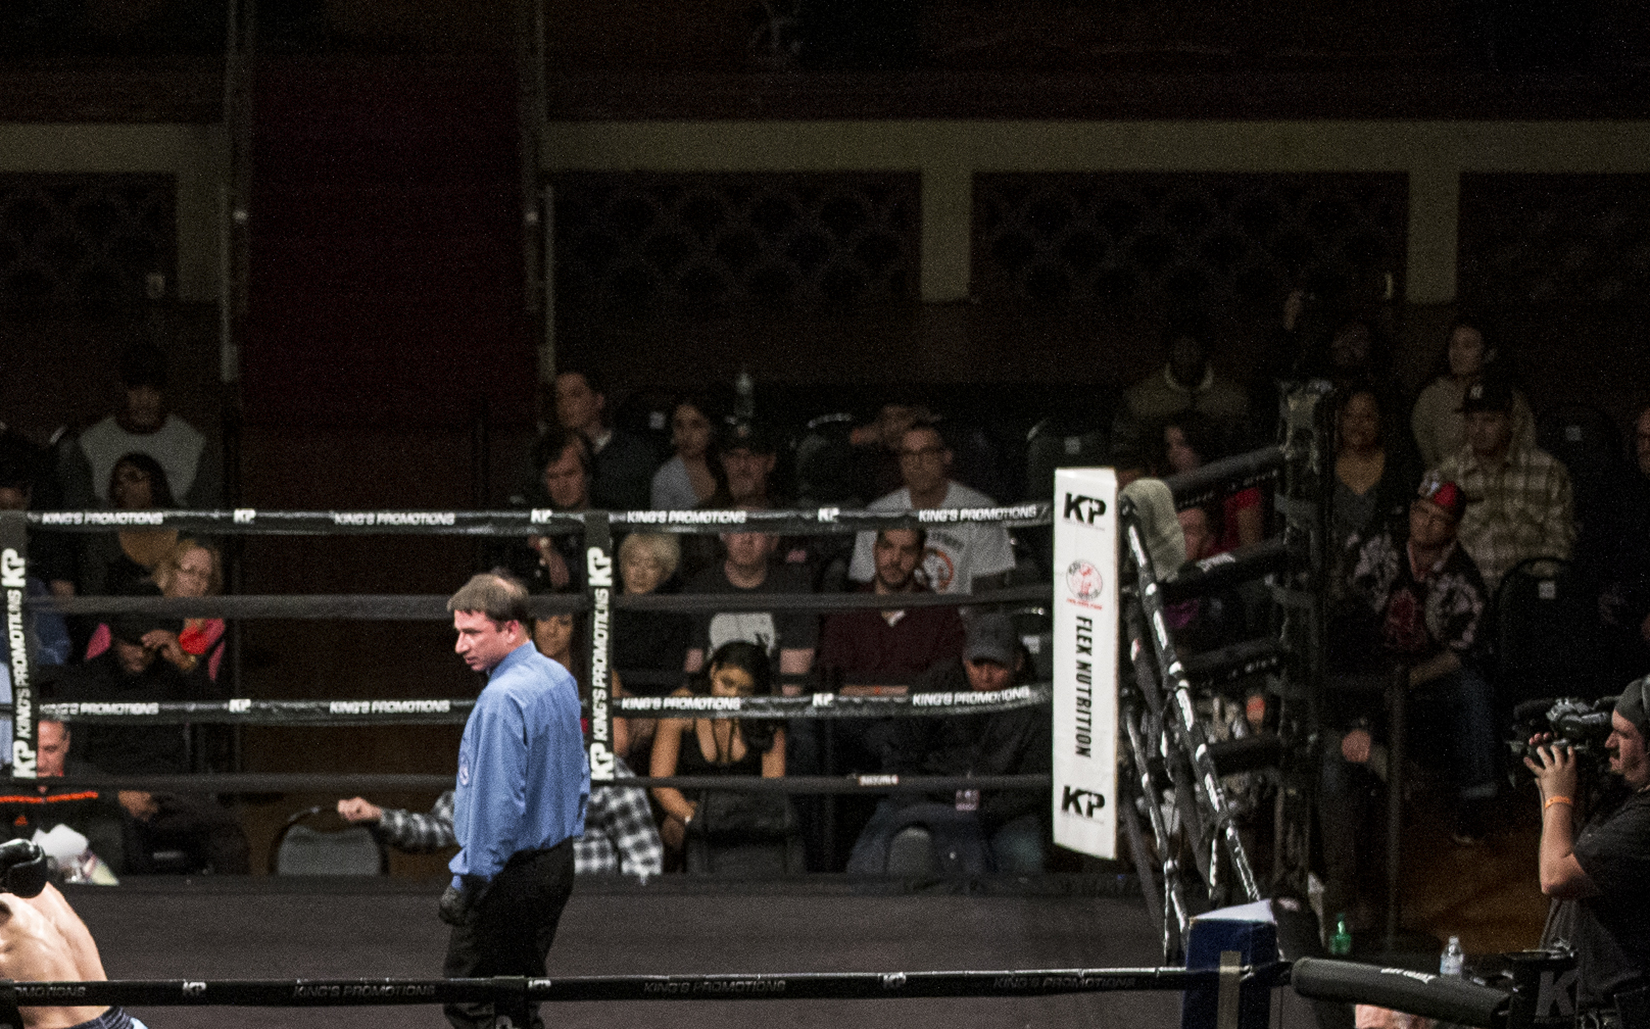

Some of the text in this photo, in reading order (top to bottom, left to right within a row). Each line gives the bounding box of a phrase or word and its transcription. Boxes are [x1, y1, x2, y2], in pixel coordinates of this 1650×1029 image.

[626, 510, 747, 525] KING'S PROMOTIONS
[918, 503, 1037, 523] KING'S PROMOTIONS
[1063, 492, 1107, 526] KP
[84, 513, 164, 525] PROMOTIONS
[334, 512, 455, 526] KING'S PROMOTIONS
[1, 548, 26, 588] KP
[1075, 614, 1093, 657] FLEX
[586, 546, 615, 781] KP KING'S PROMOTIONS KP
[329, 699, 451, 714] KING'S PROMOTIONS
[621, 696, 741, 711] KING'S PROMOTIONS
[1075, 658, 1093, 759] NUTRITION
[13, 739, 37, 780] KP
[1060, 784, 1106, 820] KP
[13, 985, 86, 998] OMOTIONS
[291, 984, 436, 998] KING'S PROMOTIONS
[692, 979, 787, 994] PROMOTIONS
